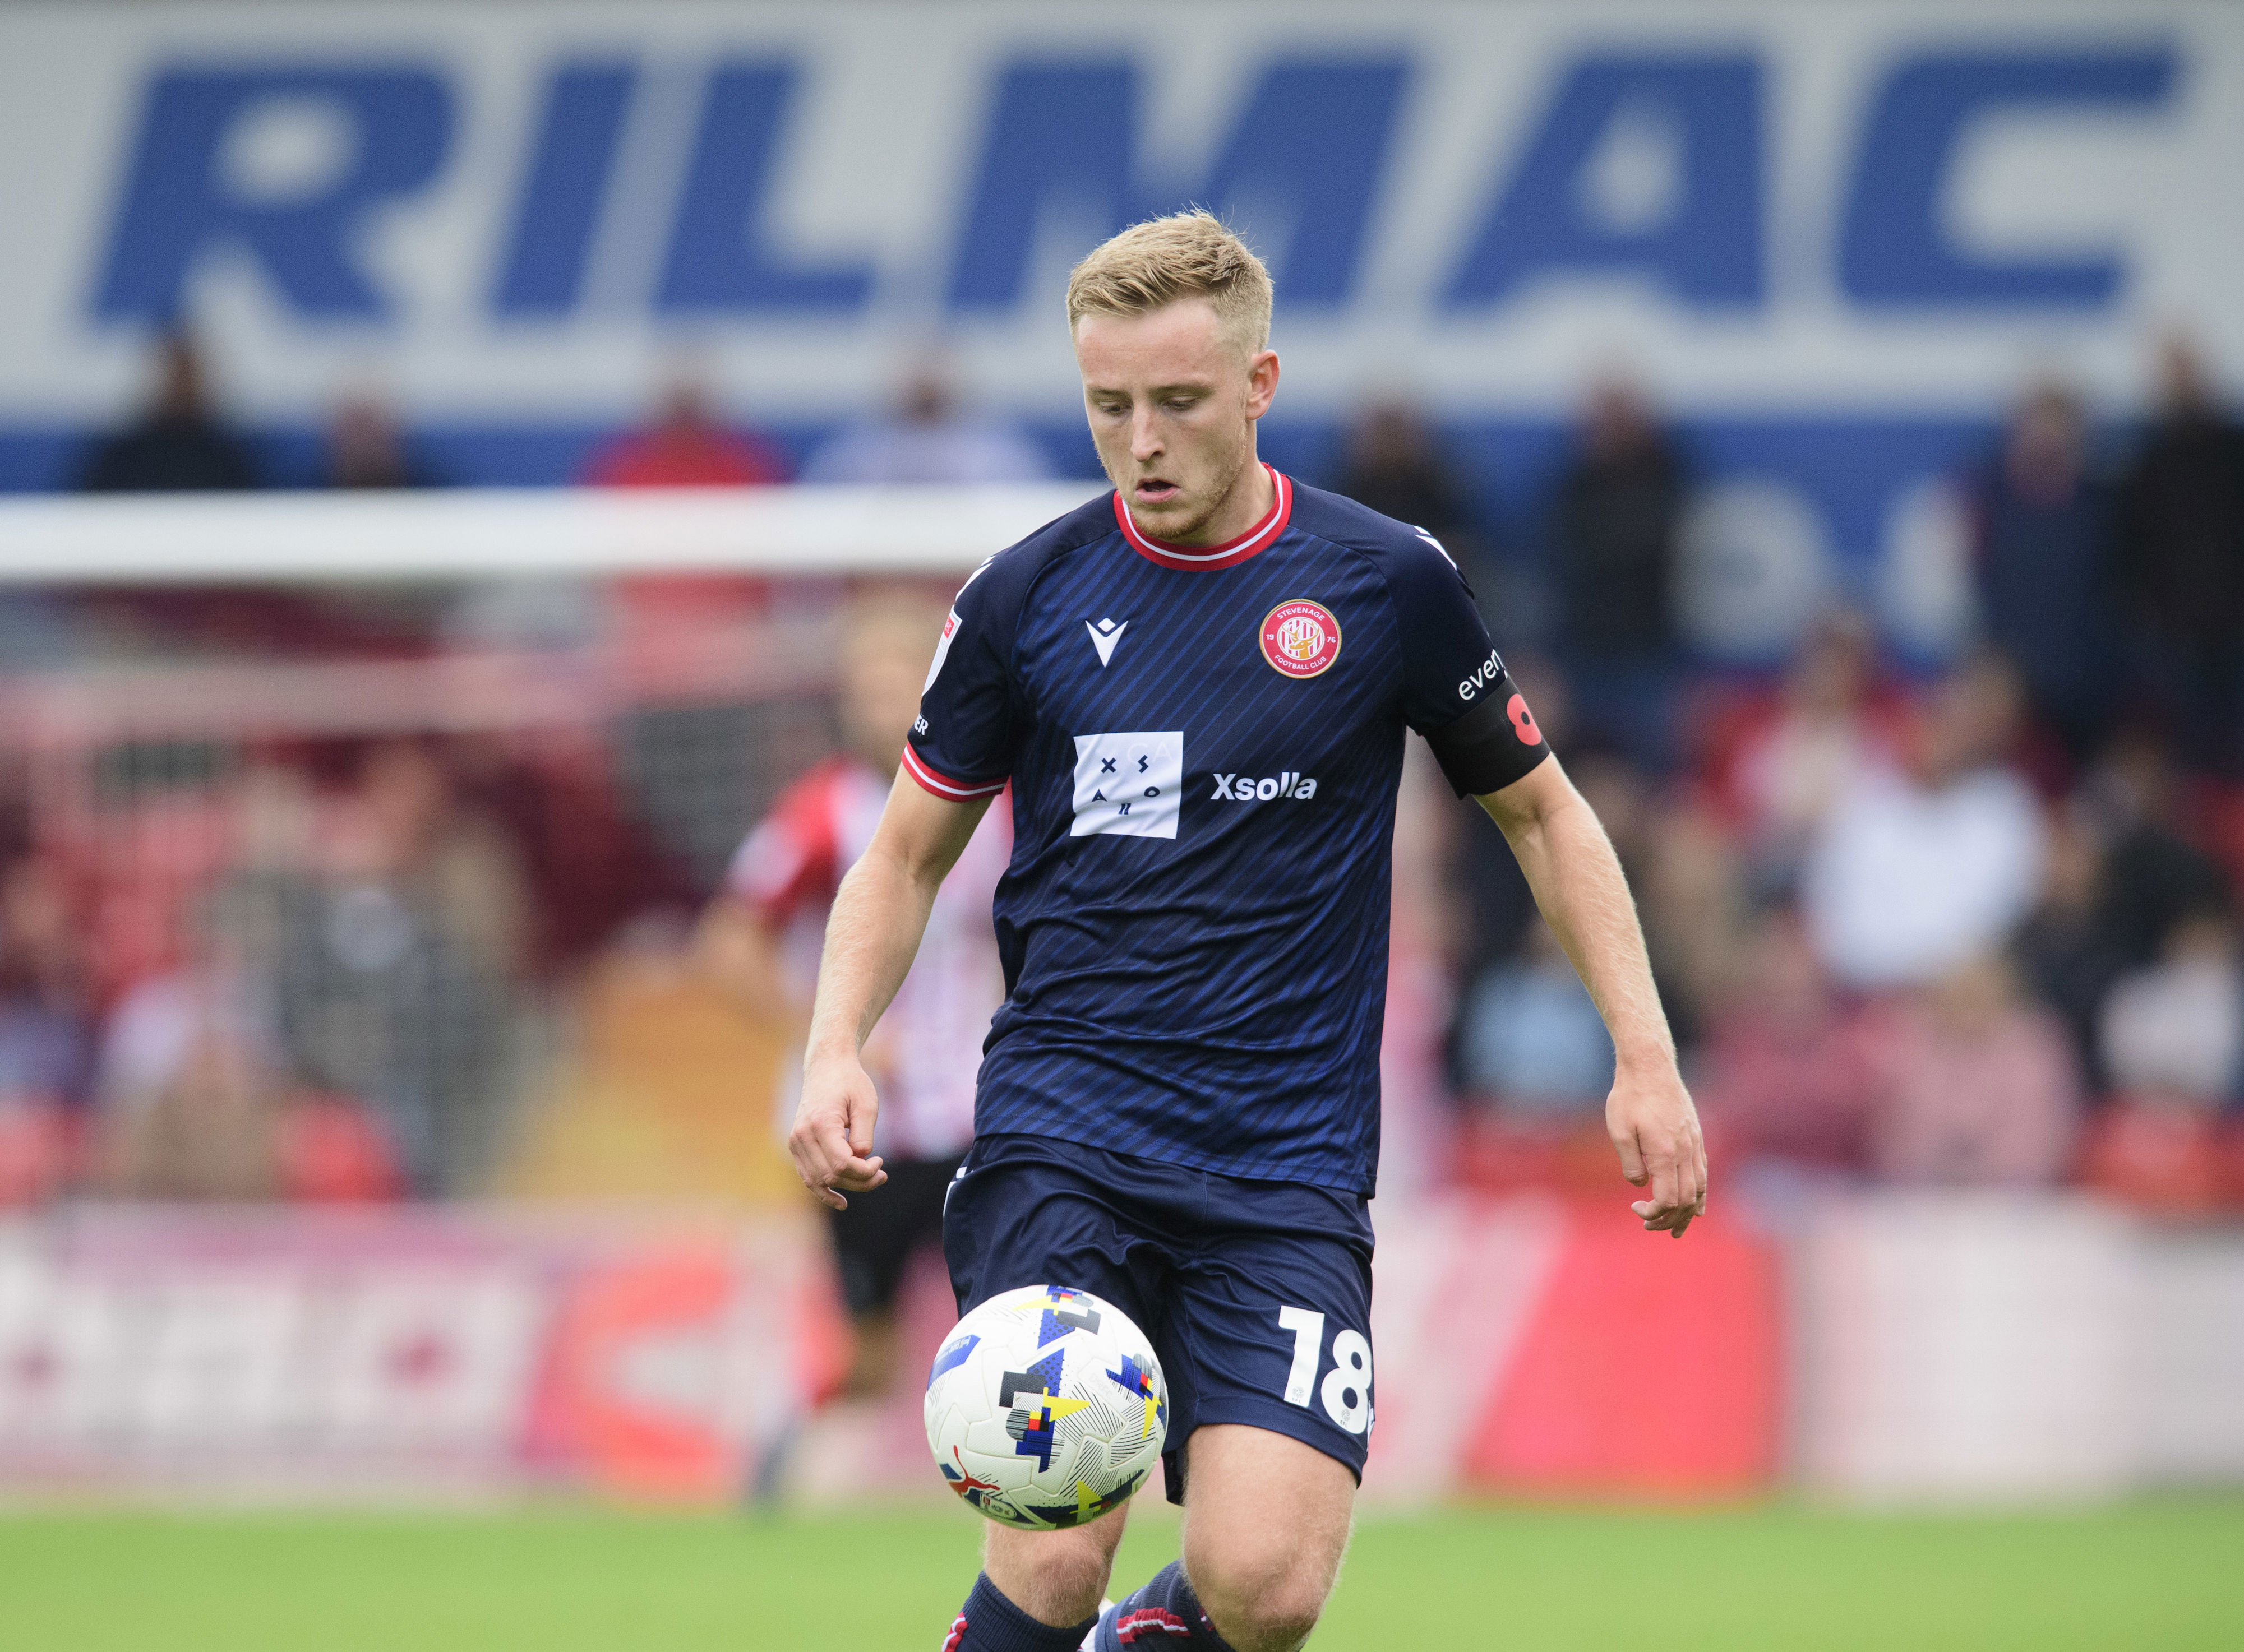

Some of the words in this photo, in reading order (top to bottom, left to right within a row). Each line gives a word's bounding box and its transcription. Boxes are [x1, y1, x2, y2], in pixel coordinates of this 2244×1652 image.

[87, 48, 2184, 320] RILMAC
[1276, 607, 1326, 621] STEVENAGE
[1274, 654, 1309, 670] FOOTBALL
[1310, 656, 1327, 669] CLUB
[1458, 649, 1508, 700] even
[1210, 771, 1318, 801] Xsolla
[1278, 1305, 1372, 1434] 18
